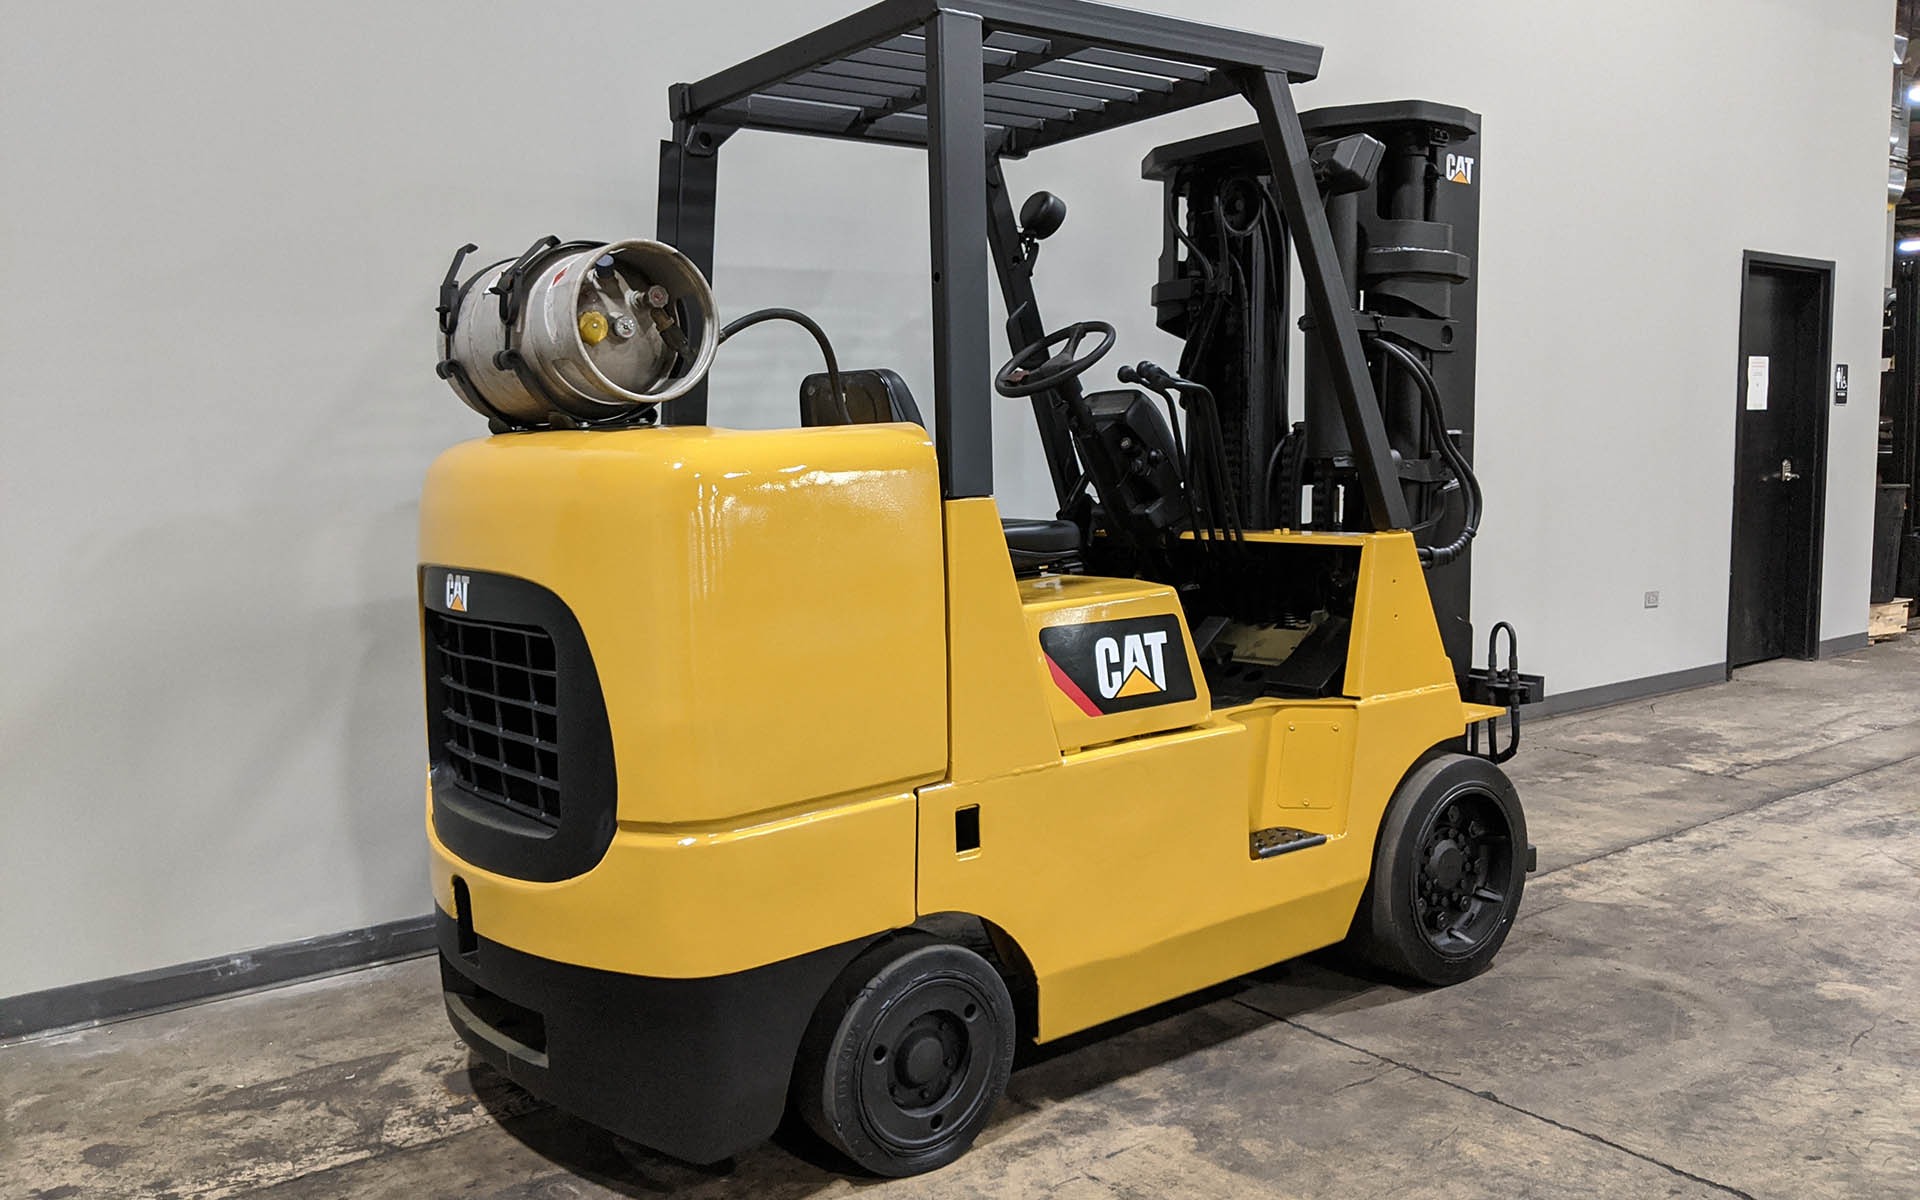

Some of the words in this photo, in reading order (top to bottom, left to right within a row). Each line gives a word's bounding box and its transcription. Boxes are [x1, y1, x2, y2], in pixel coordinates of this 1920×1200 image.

[1446, 153, 1474, 185] CAT
[446, 573, 470, 612] CAT
[1095, 630, 1168, 700] CAT
